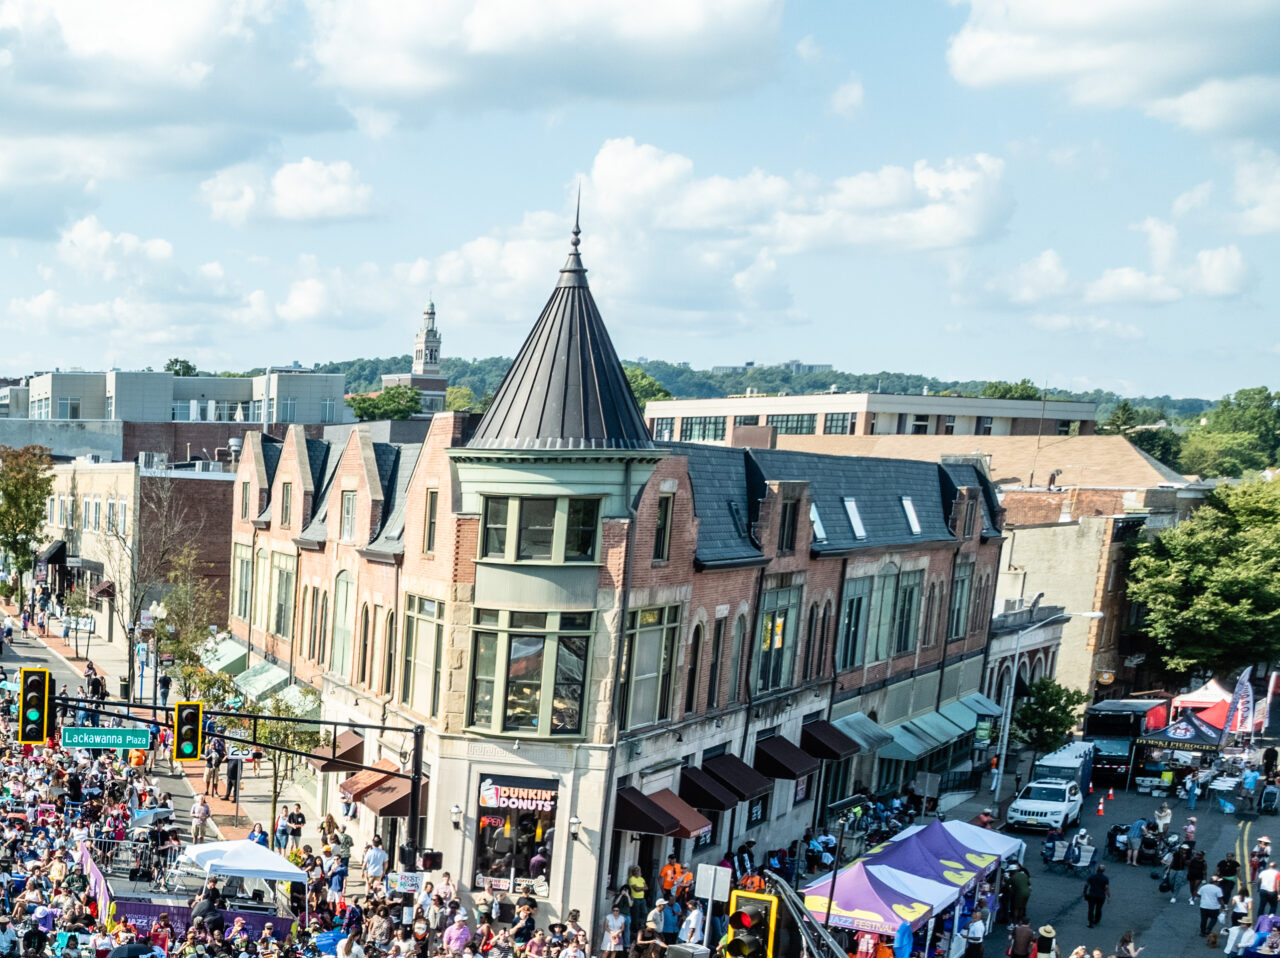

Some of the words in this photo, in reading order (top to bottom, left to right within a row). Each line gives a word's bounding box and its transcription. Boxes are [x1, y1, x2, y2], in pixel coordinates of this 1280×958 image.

[65, 732, 123, 744] Lackawanna
[126, 735, 146, 744] Plaza
[1170, 741, 1217, 750] PIEROGIES
[500, 786, 556, 801] DUNKIN'
[499, 797, 554, 811] DONUTS
[128, 918, 148, 926] JAZZ
[828, 914, 852, 926] JAZZ
[853, 919, 894, 933] FESTIVAL
